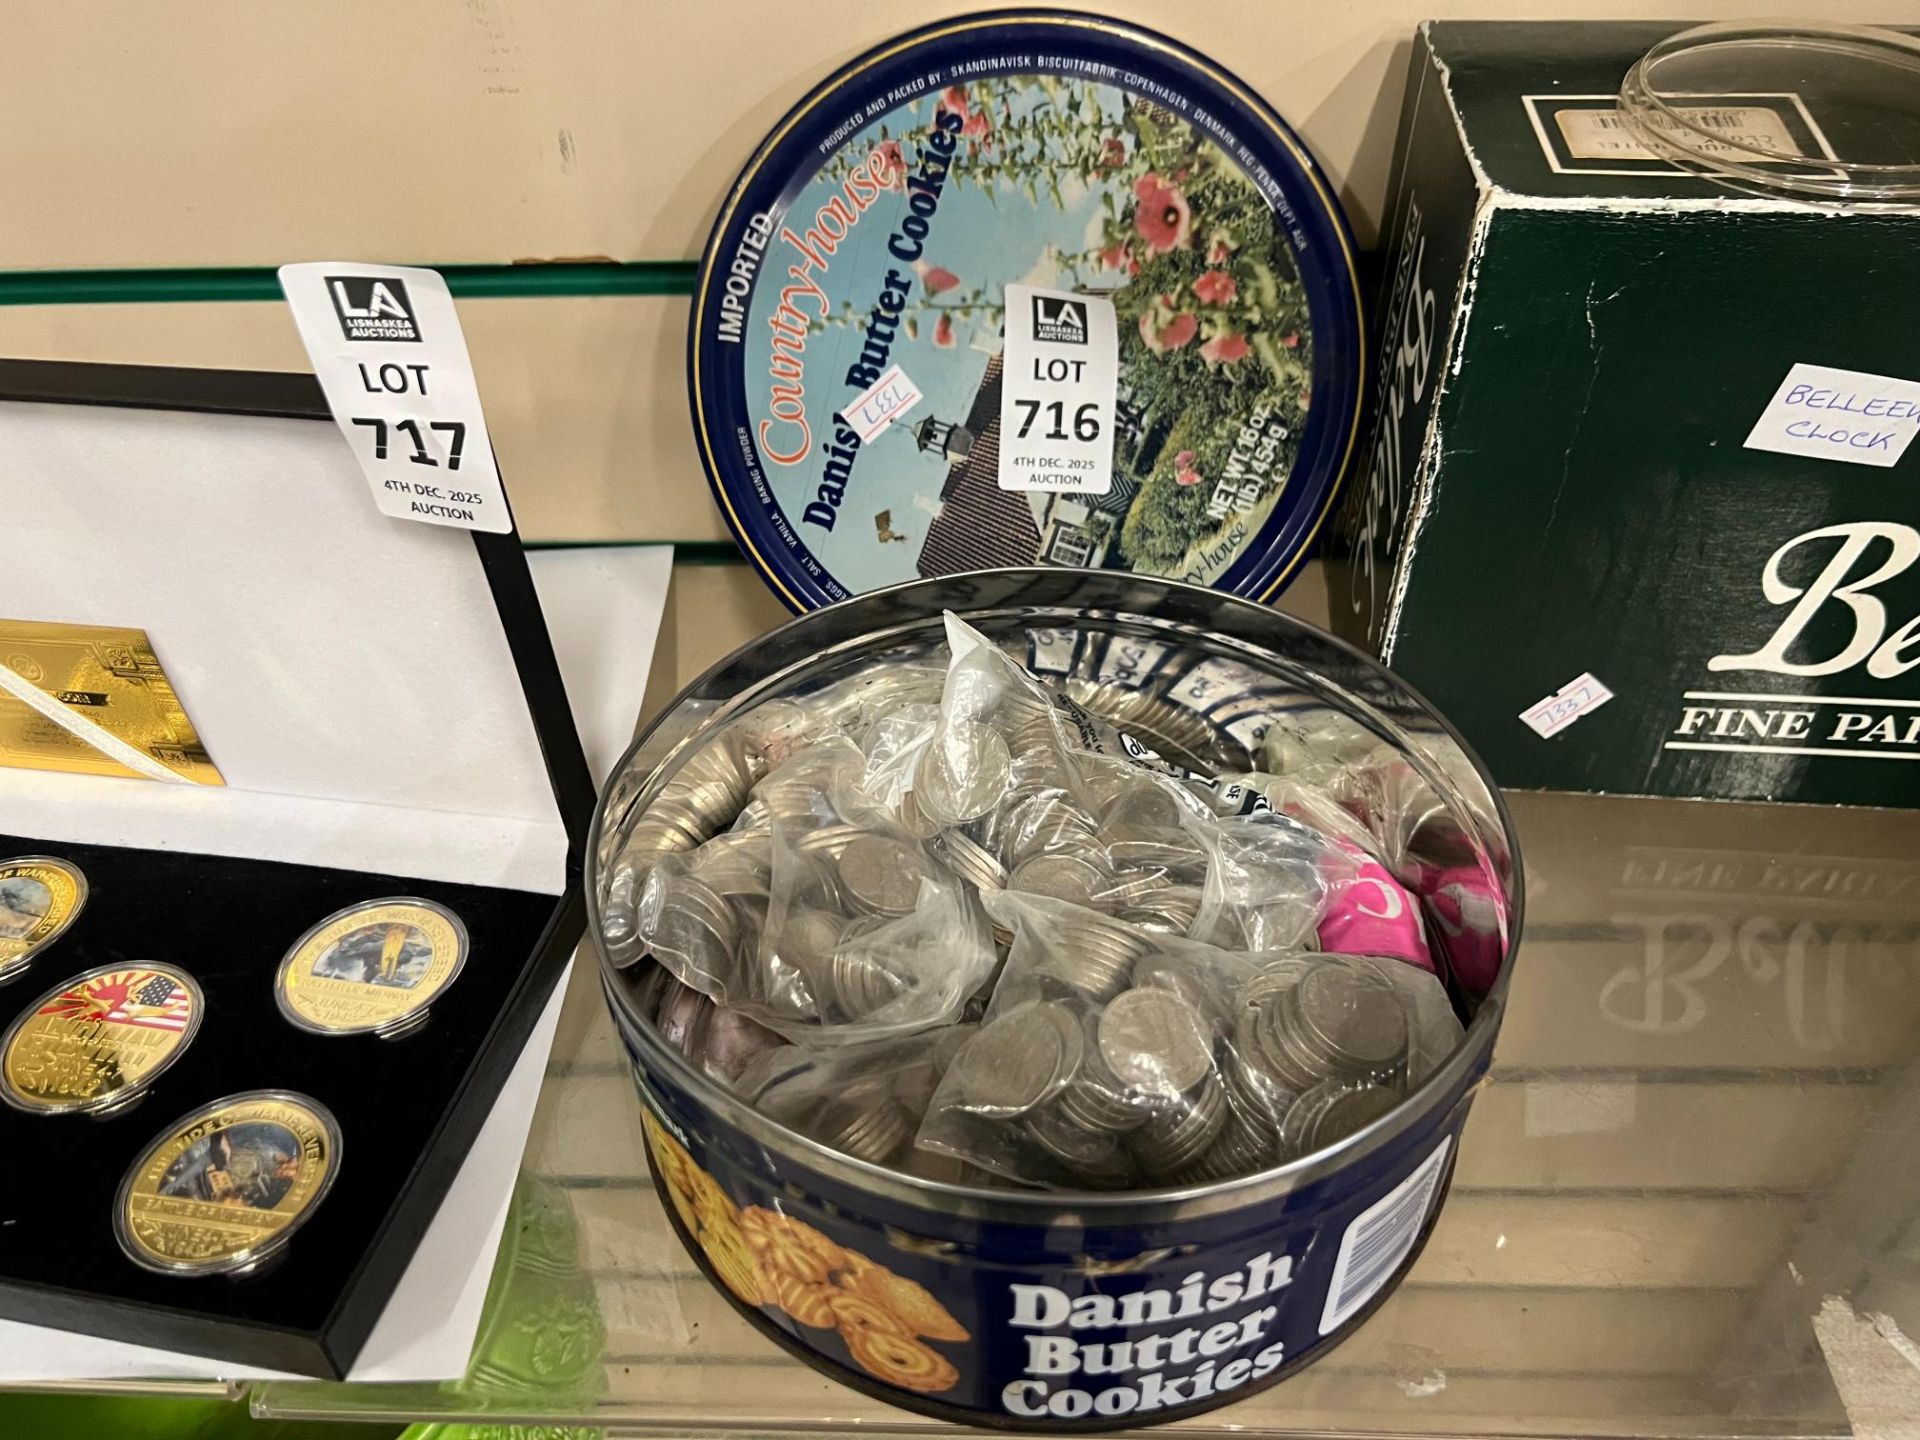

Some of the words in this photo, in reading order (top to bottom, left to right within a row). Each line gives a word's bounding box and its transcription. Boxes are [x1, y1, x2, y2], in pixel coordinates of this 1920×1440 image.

[819, 112, 864, 154] PRODUCED
[865, 98, 887, 117] AND
[887, 78, 925, 103] PACKED
[928, 71, 947, 86] BY:
[950, 55, 1031, 78] SKANDINAVISK
[1037, 55, 1117, 80] BISCUITFABRIK
[1124, 72, 1189, 112] COPENHAGEN
[1193, 107, 1236, 149] DENMARK
[718, 211, 774, 344] IMPORTED
[332, 281, 410, 318] LA
[1037, 298, 1083, 329] LA
[346, 317, 413, 329] LISNASKEA
[350, 327, 416, 339] AUCTIONS
[803, 411, 863, 533] Danis
[845, 268, 912, 390] Butter
[888, 110, 964, 263] Cookies
[1038, 332, 1085, 342] AUCTIONS
[358, 362, 430, 396] LOT
[1034, 357, 1088, 384] LOT
[1014, 399, 1101, 443] 716
[1785, 420, 1896, 450] CLOCK
[351, 417, 466, 471] 717
[737, 425, 756, 467] POWDER
[1012, 457, 1036, 468] 4TH
[1038, 457, 1065, 469] DEC.
[1068, 458, 1095, 470] 2025
[1029, 474, 1083, 486] AUCTION
[384, 480, 411, 494] 4TH
[413, 483, 447, 501] DEC.
[449, 490, 483, 505] 2025
[750, 468, 772, 505] BAKING
[411, 501, 475, 522] AUCTION
[1535, 686, 1592, 725] 7337
[1672, 706, 1819, 739] FINE
[1008, 1251, 1293, 1330] Danish
[1023, 1305, 1278, 1376] Butter
[1002, 1341, 1285, 1419] Cookies
